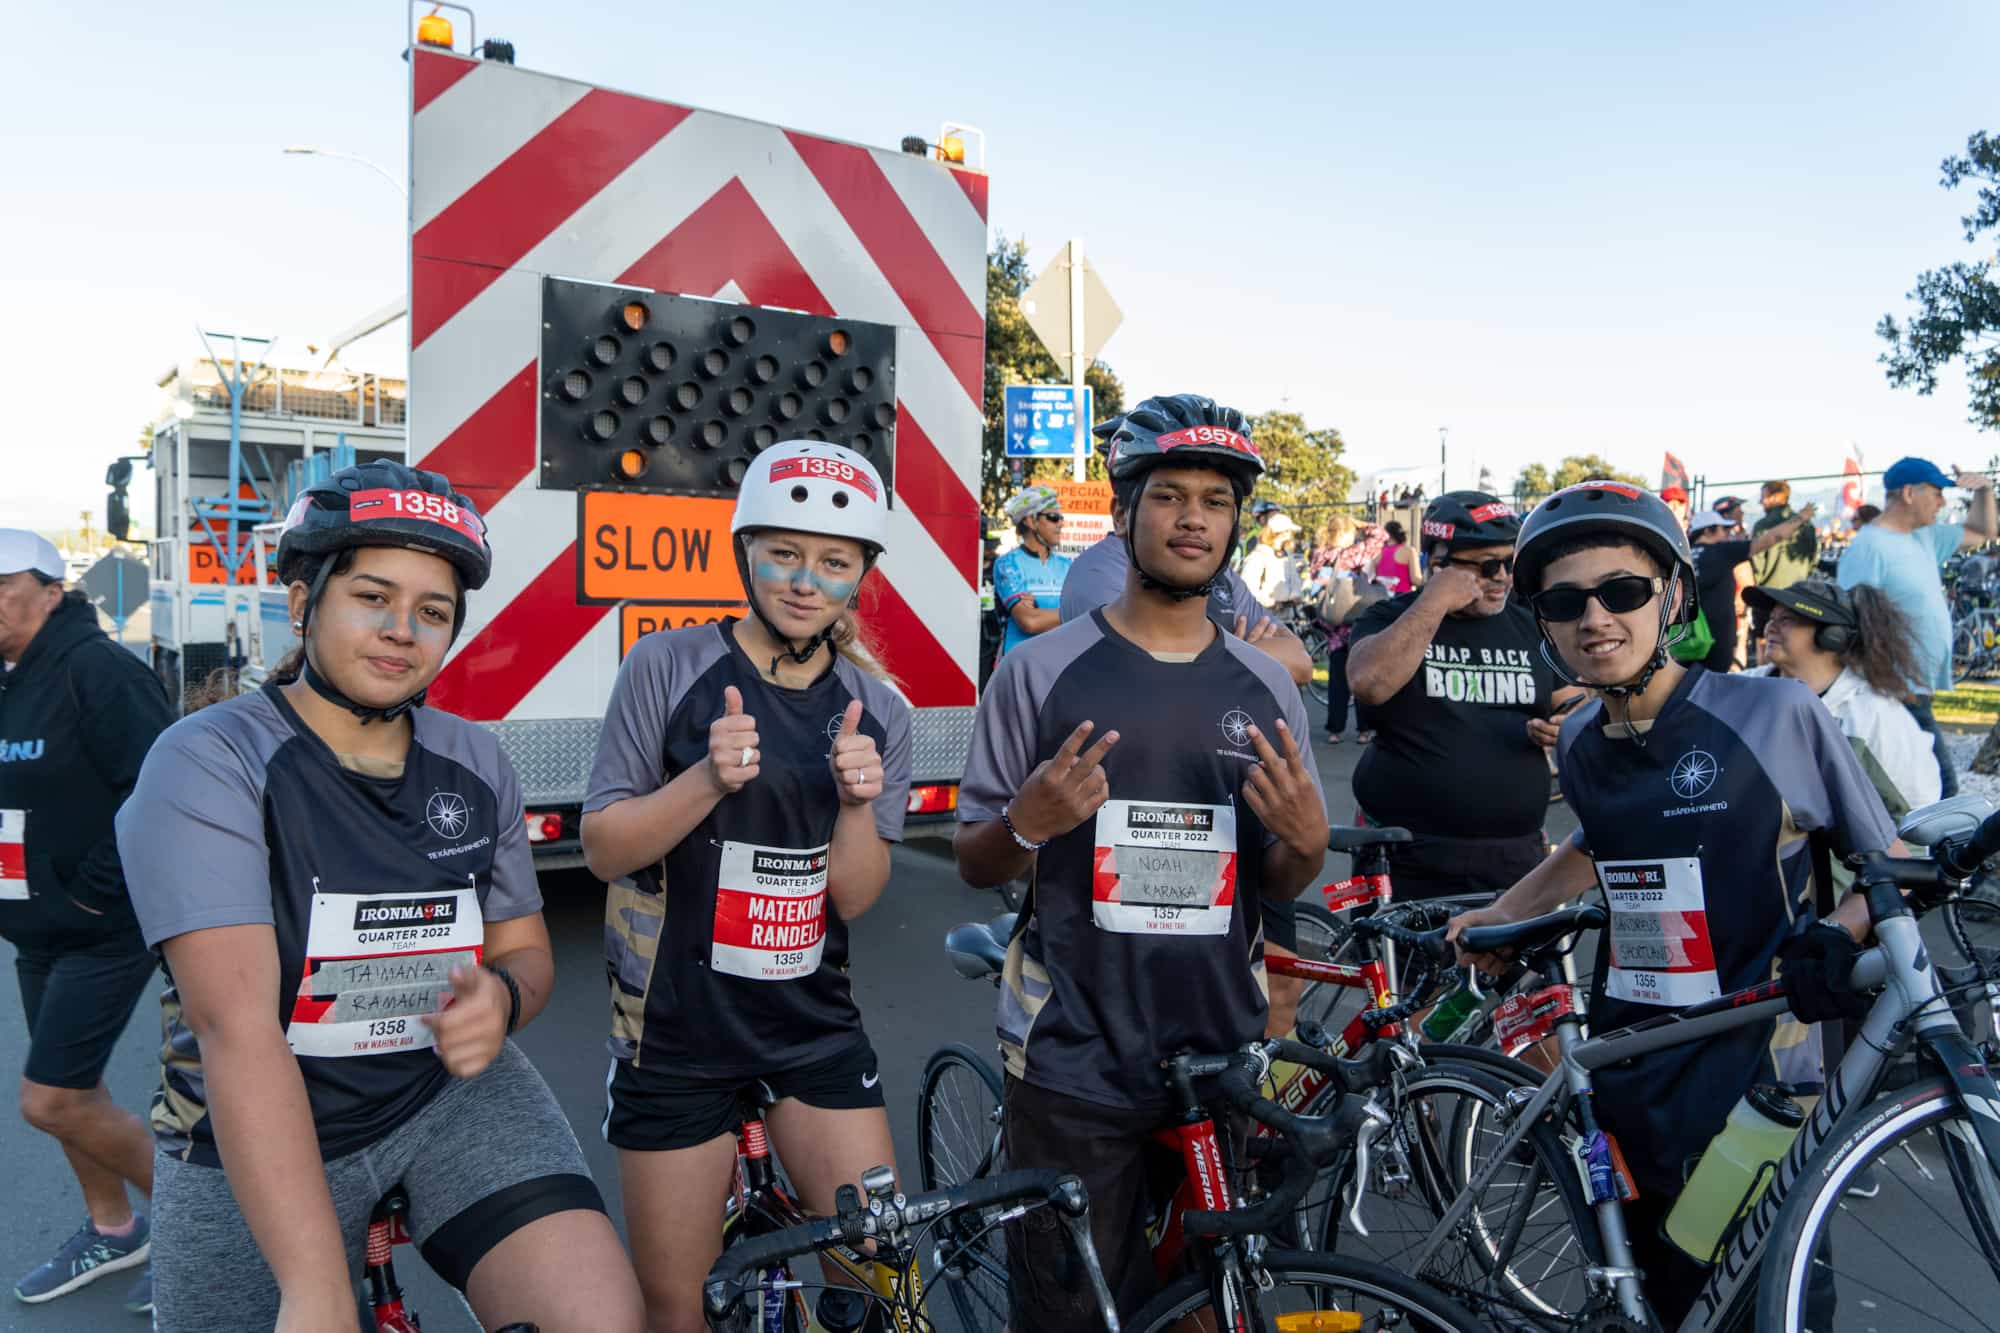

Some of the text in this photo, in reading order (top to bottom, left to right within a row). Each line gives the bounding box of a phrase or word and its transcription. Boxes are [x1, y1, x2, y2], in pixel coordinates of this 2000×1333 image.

[1185, 427, 1238, 445] 1357
[798, 458, 854, 480] 1359
[389, 492, 459, 523] 1358
[1423, 520, 1447, 538] 1334
[594, 524, 711, 572] SLOW
[1424, 644, 1531, 667] SNAP BACK
[1426, 666, 1536, 705] BOXING
[1131, 830, 1208, 841] QUARTER 2022
[1138, 857, 1183, 873] NOAH
[756, 875, 808, 887] QUARTER
[1640, 891, 1663, 901] 2022
[1152, 907, 1182, 919] 1357
[358, 927, 450, 943] QUARTER 2022
[751, 922, 819, 947] RANDELL
[392, 941, 416, 950] TEAM
[773, 952, 803, 966] 1359
[1634, 975, 1656, 988] 1356
[368, 1019, 406, 1036] 1358
[370, 1038, 398, 1049] WAHINE
